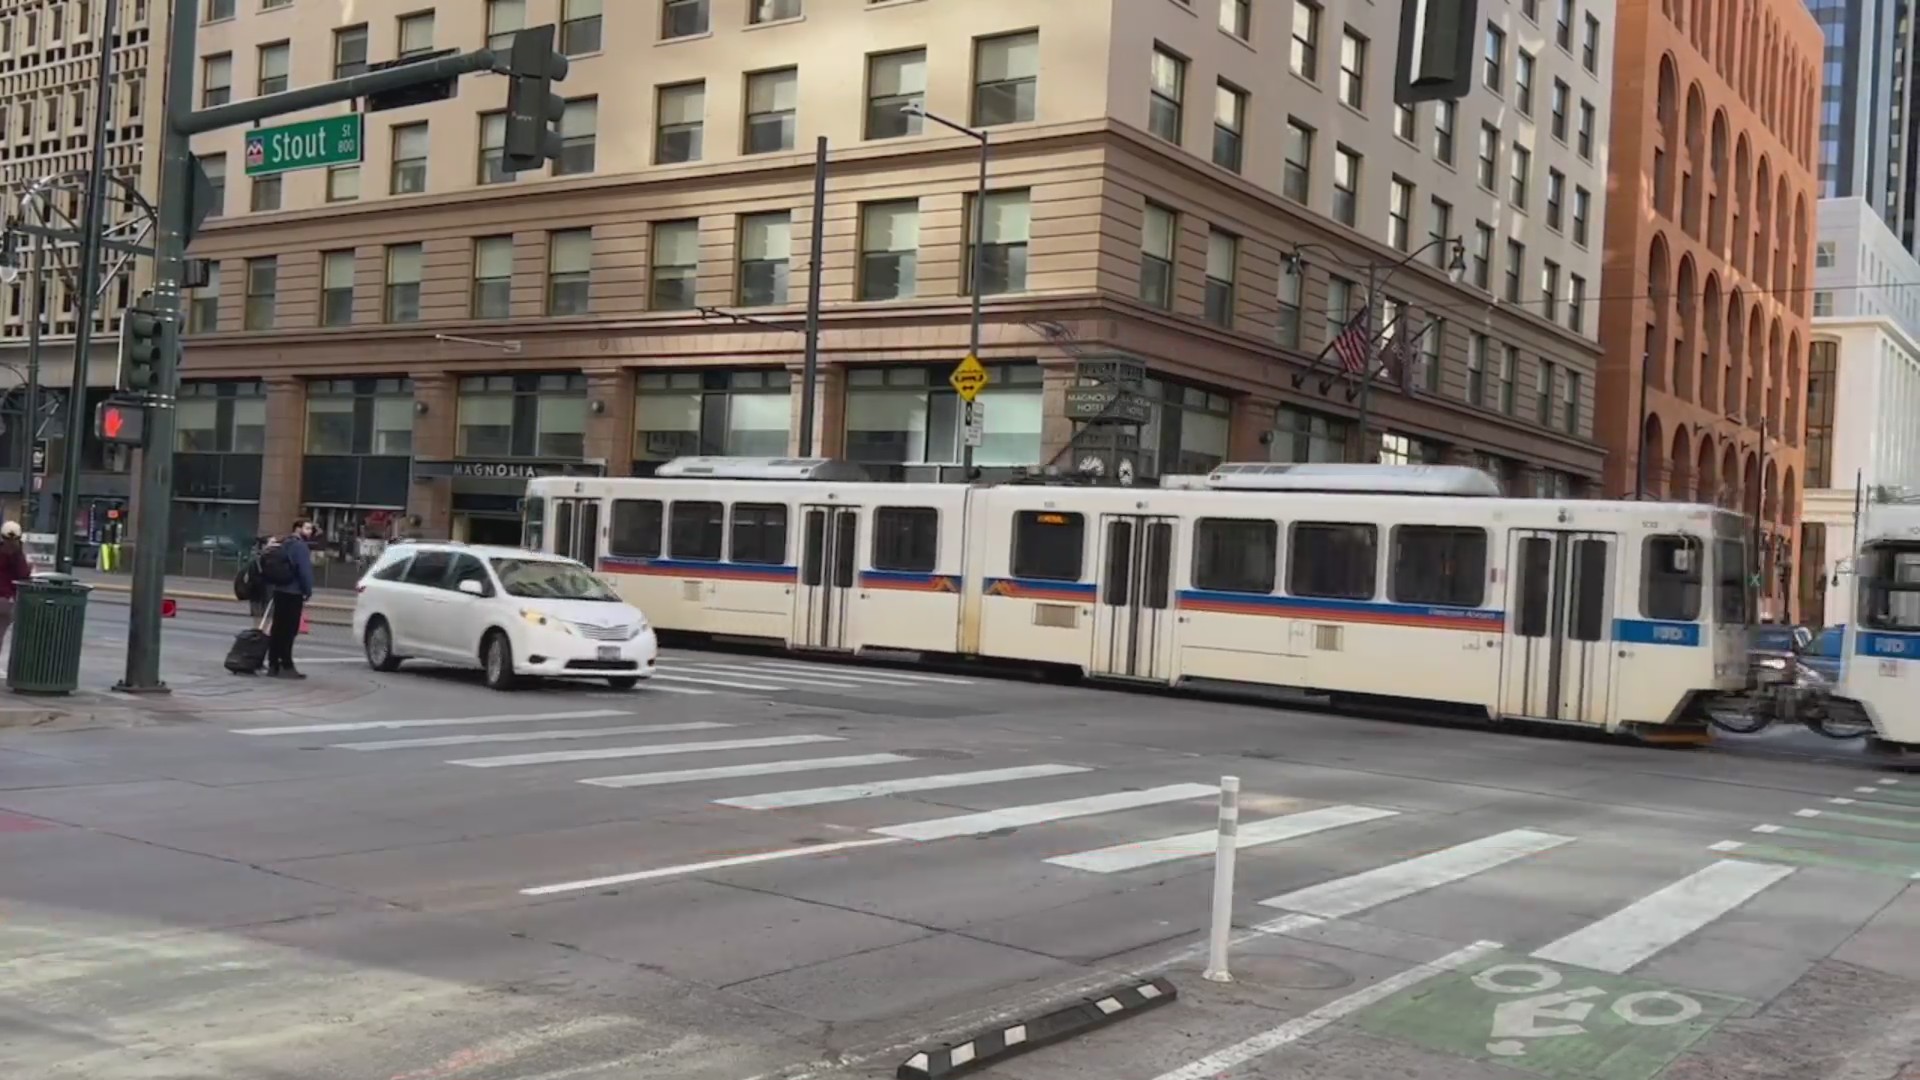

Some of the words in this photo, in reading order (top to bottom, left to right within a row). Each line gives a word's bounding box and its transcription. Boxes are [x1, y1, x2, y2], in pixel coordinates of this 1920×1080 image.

[271, 126, 327, 163] Stout
[341, 123, 352, 137] St
[337, 139, 355, 153] 800
[453, 463, 537, 477] MAGNOLIA
